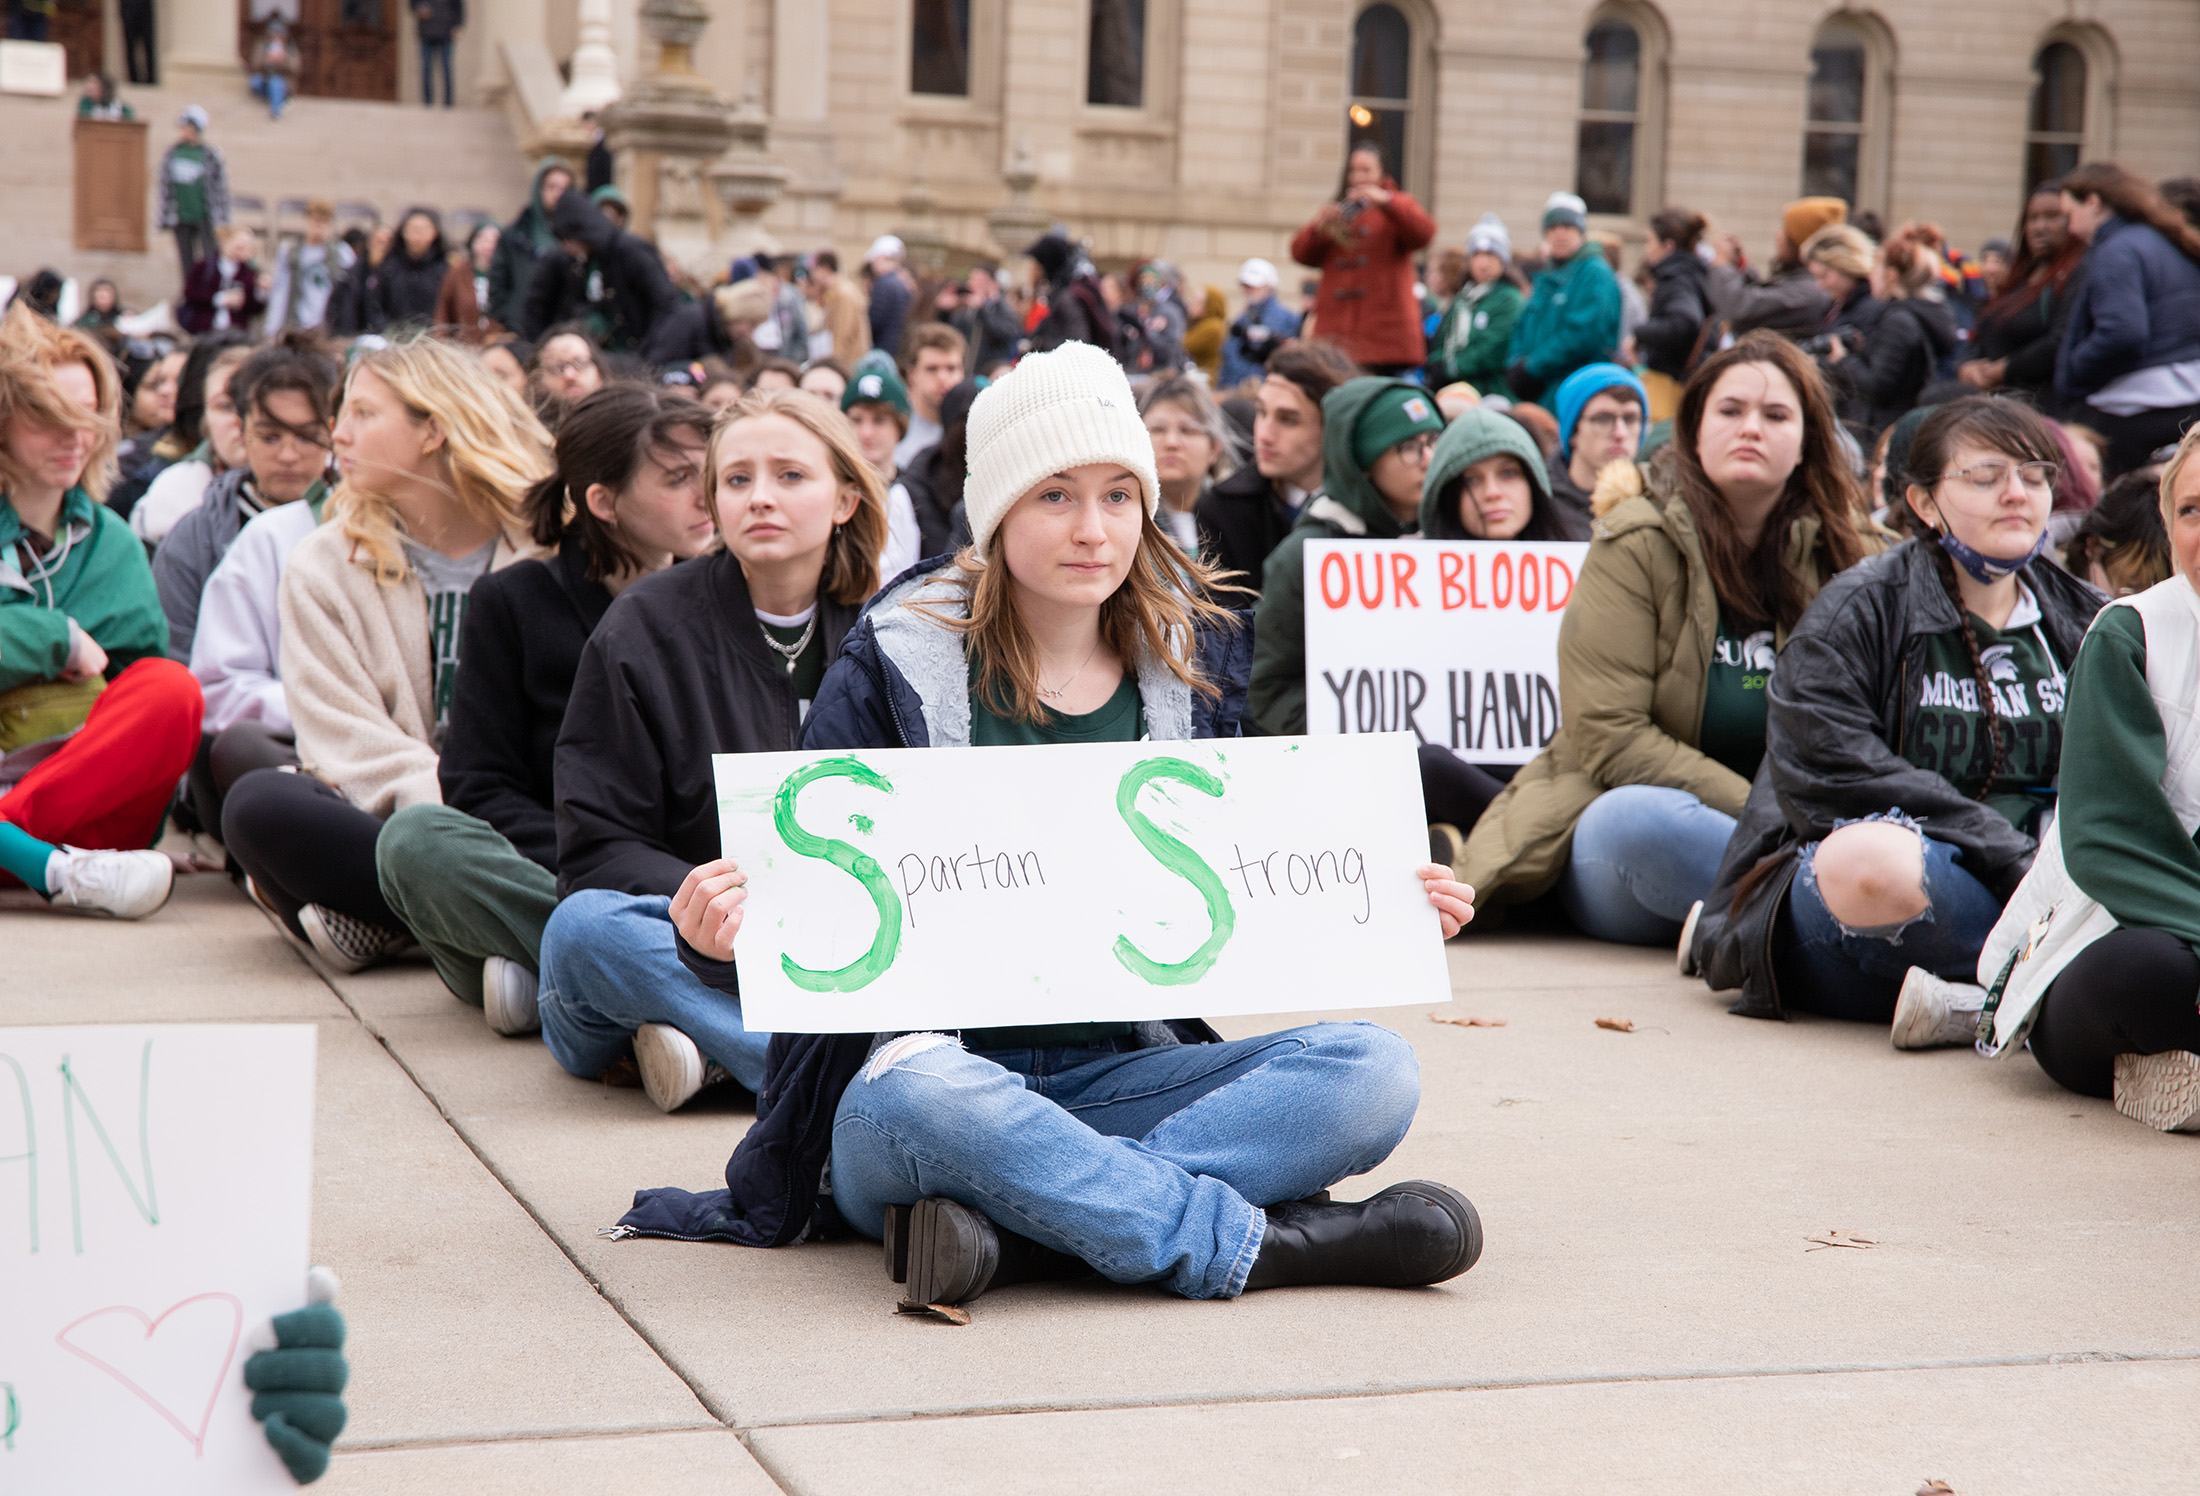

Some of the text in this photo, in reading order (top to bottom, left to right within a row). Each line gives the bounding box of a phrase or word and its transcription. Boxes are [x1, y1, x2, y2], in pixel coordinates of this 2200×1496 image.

[1320, 551, 1574, 613] OUR BLOOD
[1322, 668, 1559, 750] YOUR HAND
[1742, 674, 1769, 690] 20
[774, 754, 1371, 993] Spartan Strong
